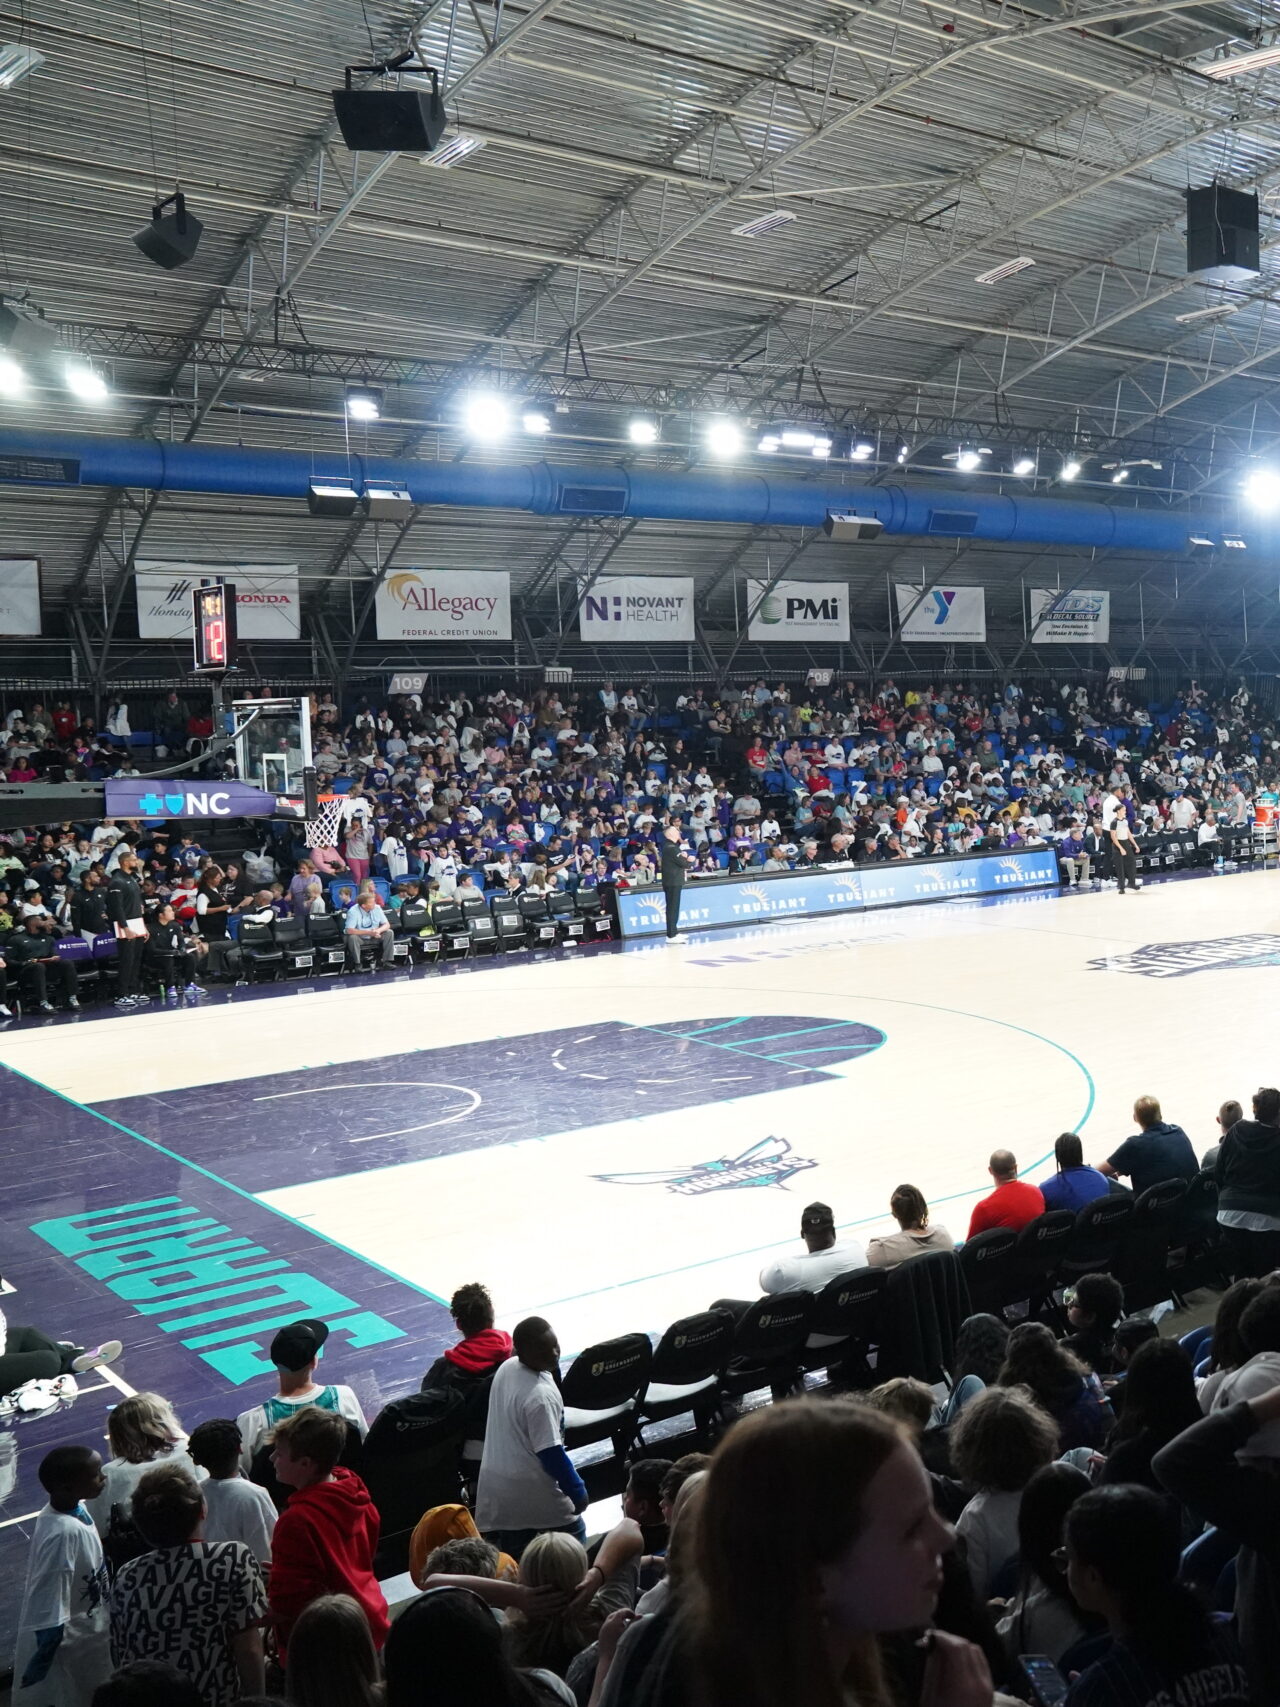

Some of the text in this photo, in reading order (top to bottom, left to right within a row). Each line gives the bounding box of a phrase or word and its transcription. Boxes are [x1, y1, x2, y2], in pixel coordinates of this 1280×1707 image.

[402, 586, 498, 621] Allegacy
[626, 597, 683, 608] NOVANT
[786, 597, 839, 620] PMi
[626, 610, 679, 621] HEALTH
[394, 677, 422, 690] 109
[186, 792, 231, 815] NC
[994, 869, 1053, 884] TRULIANT
[733, 896, 807, 915] TRULIANT
[671, 1157, 814, 1194] HORNETS
